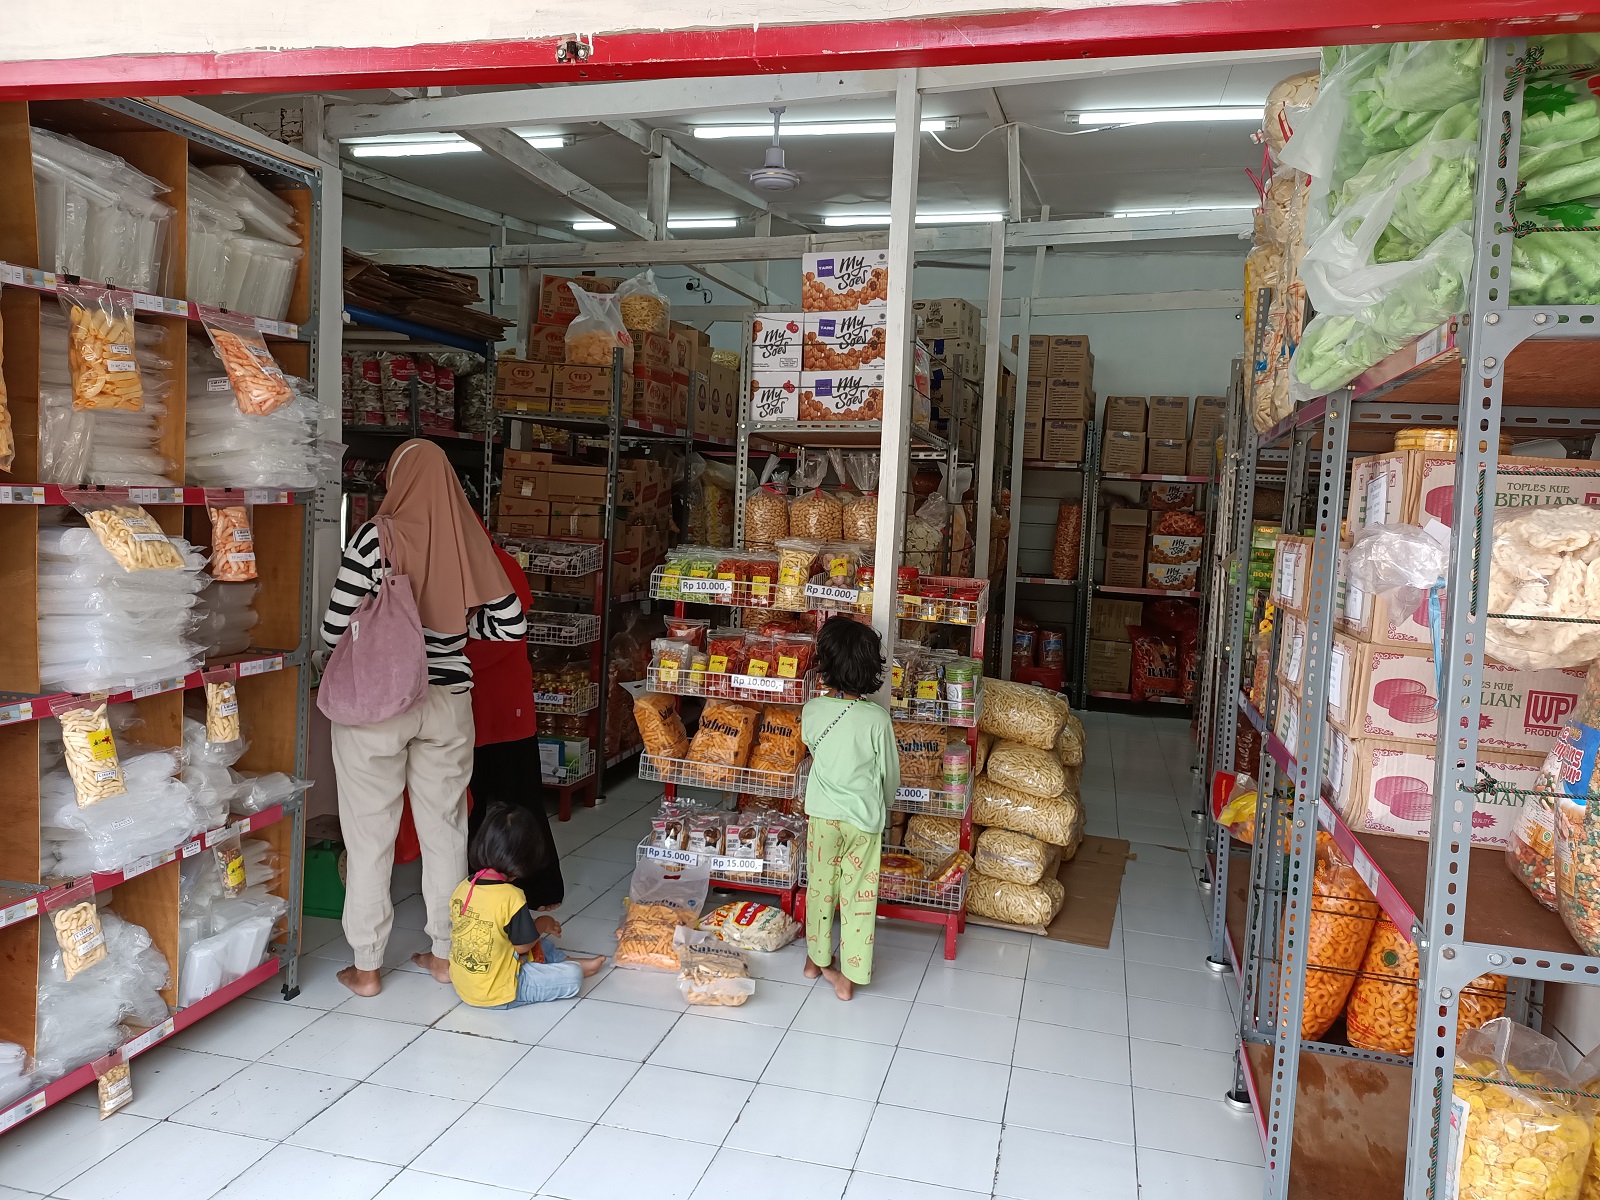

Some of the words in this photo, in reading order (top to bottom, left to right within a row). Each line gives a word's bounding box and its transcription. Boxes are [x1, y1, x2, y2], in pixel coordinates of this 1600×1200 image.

[839, 255, 872, 275] My
[834, 270, 868, 290] Soes
[840, 315, 873, 336] My
[763, 329, 792, 346] My
[835, 329, 869, 349] Soes
[760, 341, 788, 359] Soes
[517, 368, 530, 377] TES
[836, 376, 869, 396] My
[761, 388, 789, 405] My
[832, 388, 865, 409] Soes
[756, 400, 786, 418] Soes
[1507, 482, 1546, 493] TOPLES
[1549, 485, 1570, 494] KUE
[682, 581, 694, 591] Rp
[696, 582, 730, 592] 10.000,-
[806, 585, 819, 595] Rp
[820, 587, 857, 600] 10.000,-
[733, 676, 745, 686] Rp
[747, 678, 782, 690] 10.000,-
[1493, 682, 1514, 691] KUE
[1532, 694, 1571, 725] WP
[1496, 780, 1517, 789] KUE
[648, 848, 660, 858] Rp
[662, 850, 696, 864] 15.000,-
[712, 858, 724, 868] Rp
[726, 860, 762, 870] 15.000,-
[857, 890, 877, 898] LOL
